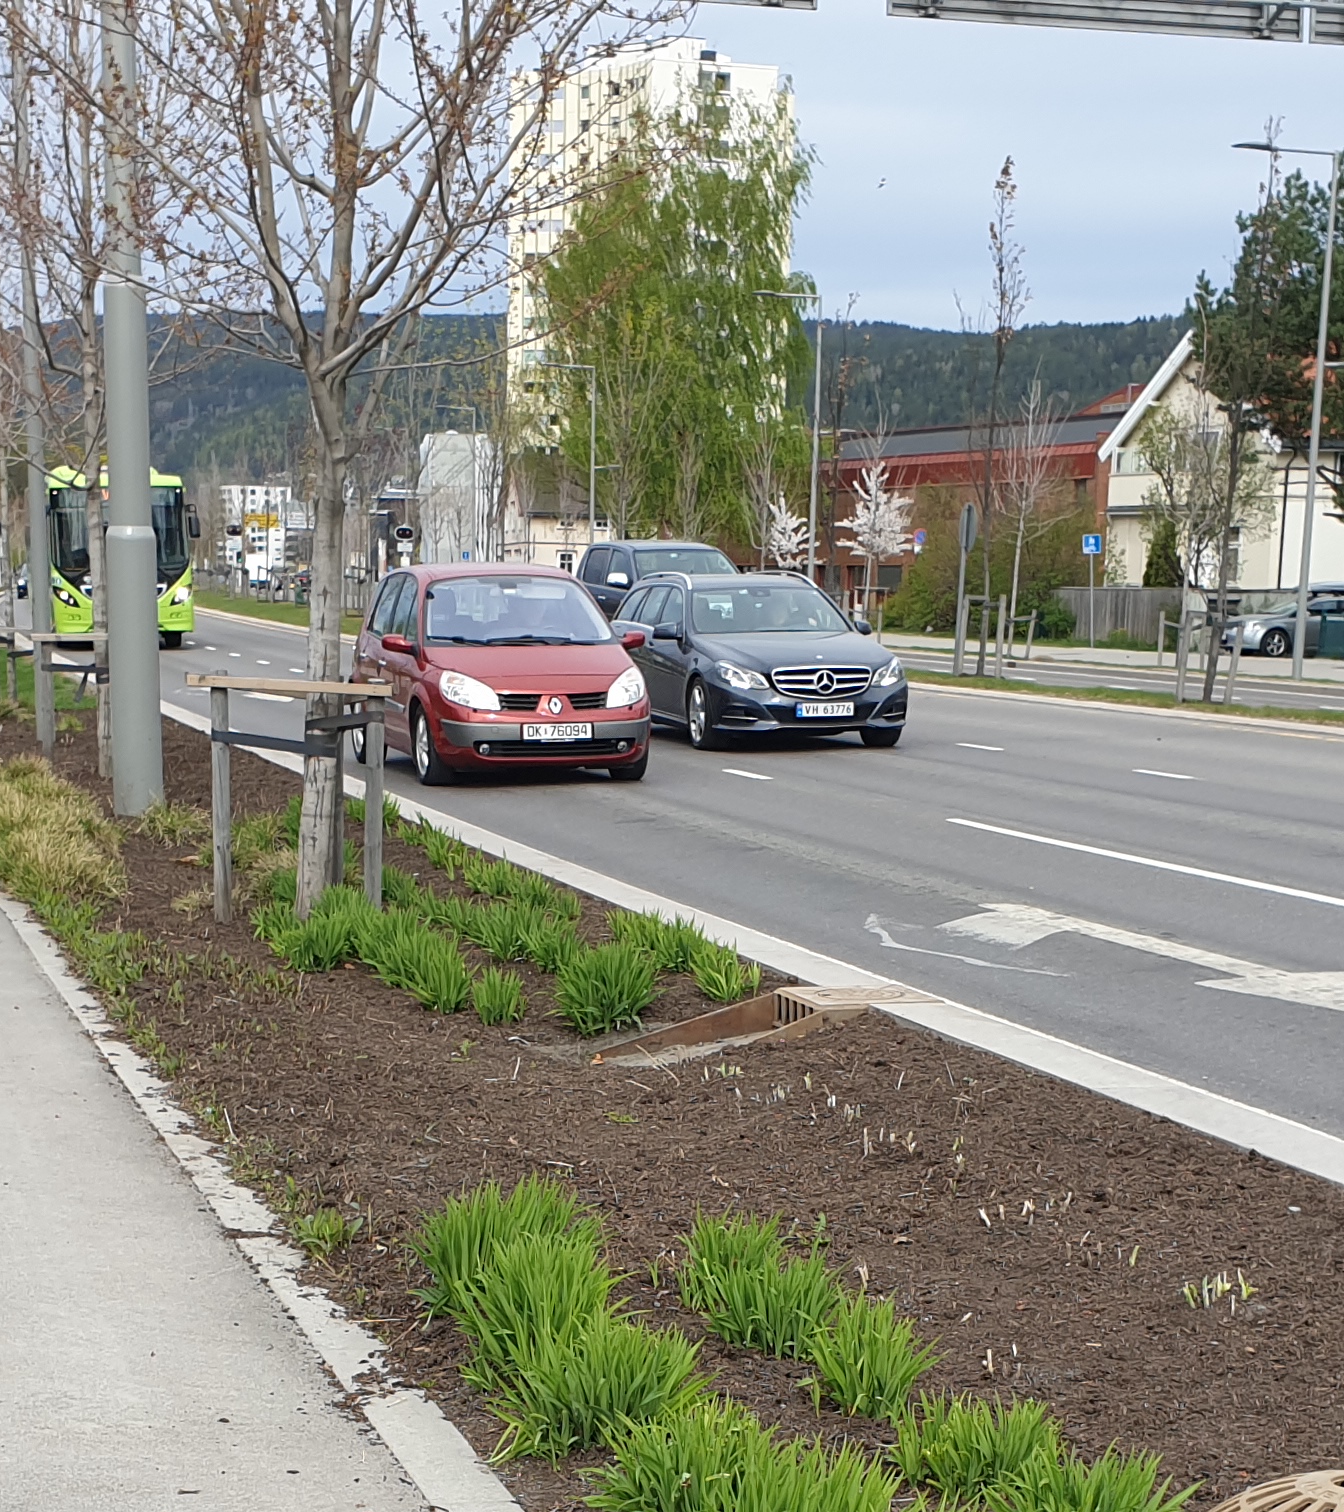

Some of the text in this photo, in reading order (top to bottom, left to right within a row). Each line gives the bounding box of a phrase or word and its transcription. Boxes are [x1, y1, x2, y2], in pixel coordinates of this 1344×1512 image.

[805, 704, 852, 714] VH 63776
[527, 724, 588, 738] DK 76094
